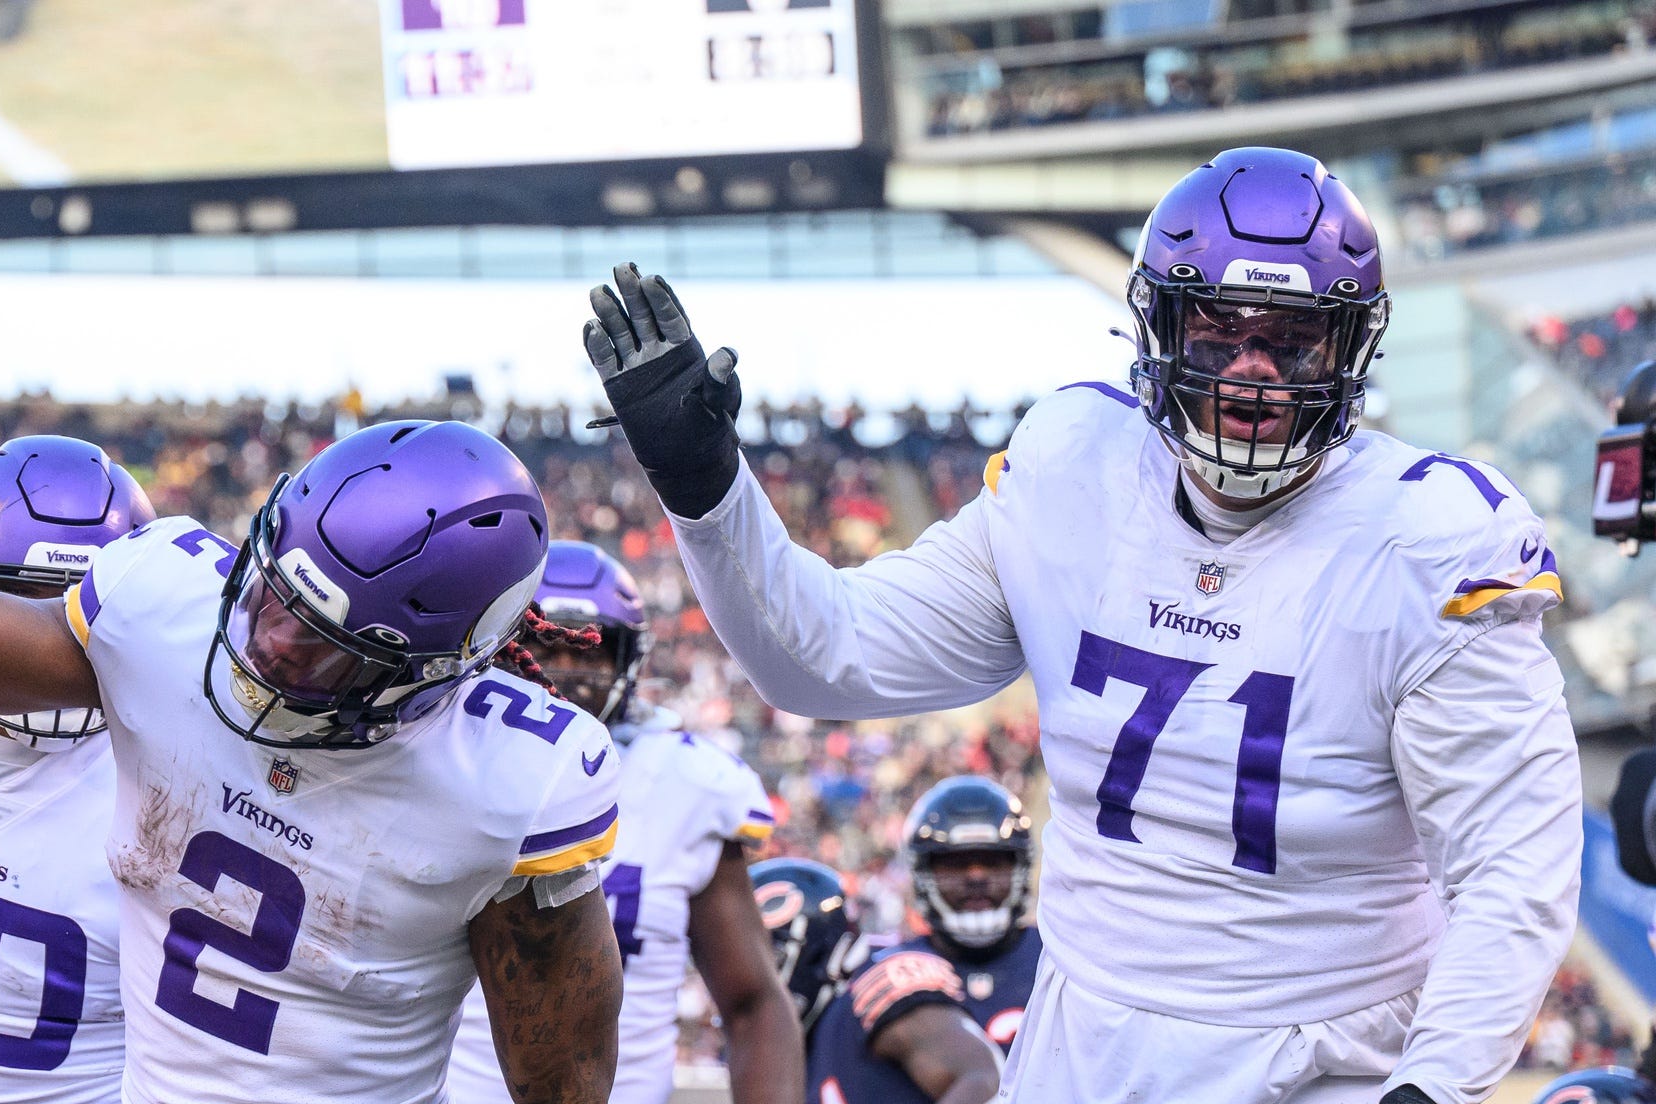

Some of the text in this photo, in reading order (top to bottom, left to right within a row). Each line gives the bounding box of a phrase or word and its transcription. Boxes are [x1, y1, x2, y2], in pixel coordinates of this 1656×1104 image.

[1199, 573, 1219, 592] NFL
[1149, 599, 1242, 643] VIKINGS
[464, 680, 577, 746] 2
[268, 770, 293, 792] NFL
[1070, 630, 1294, 875] 71
[222, 782, 314, 851] VIKINGS
[155, 830, 307, 1055] 2
